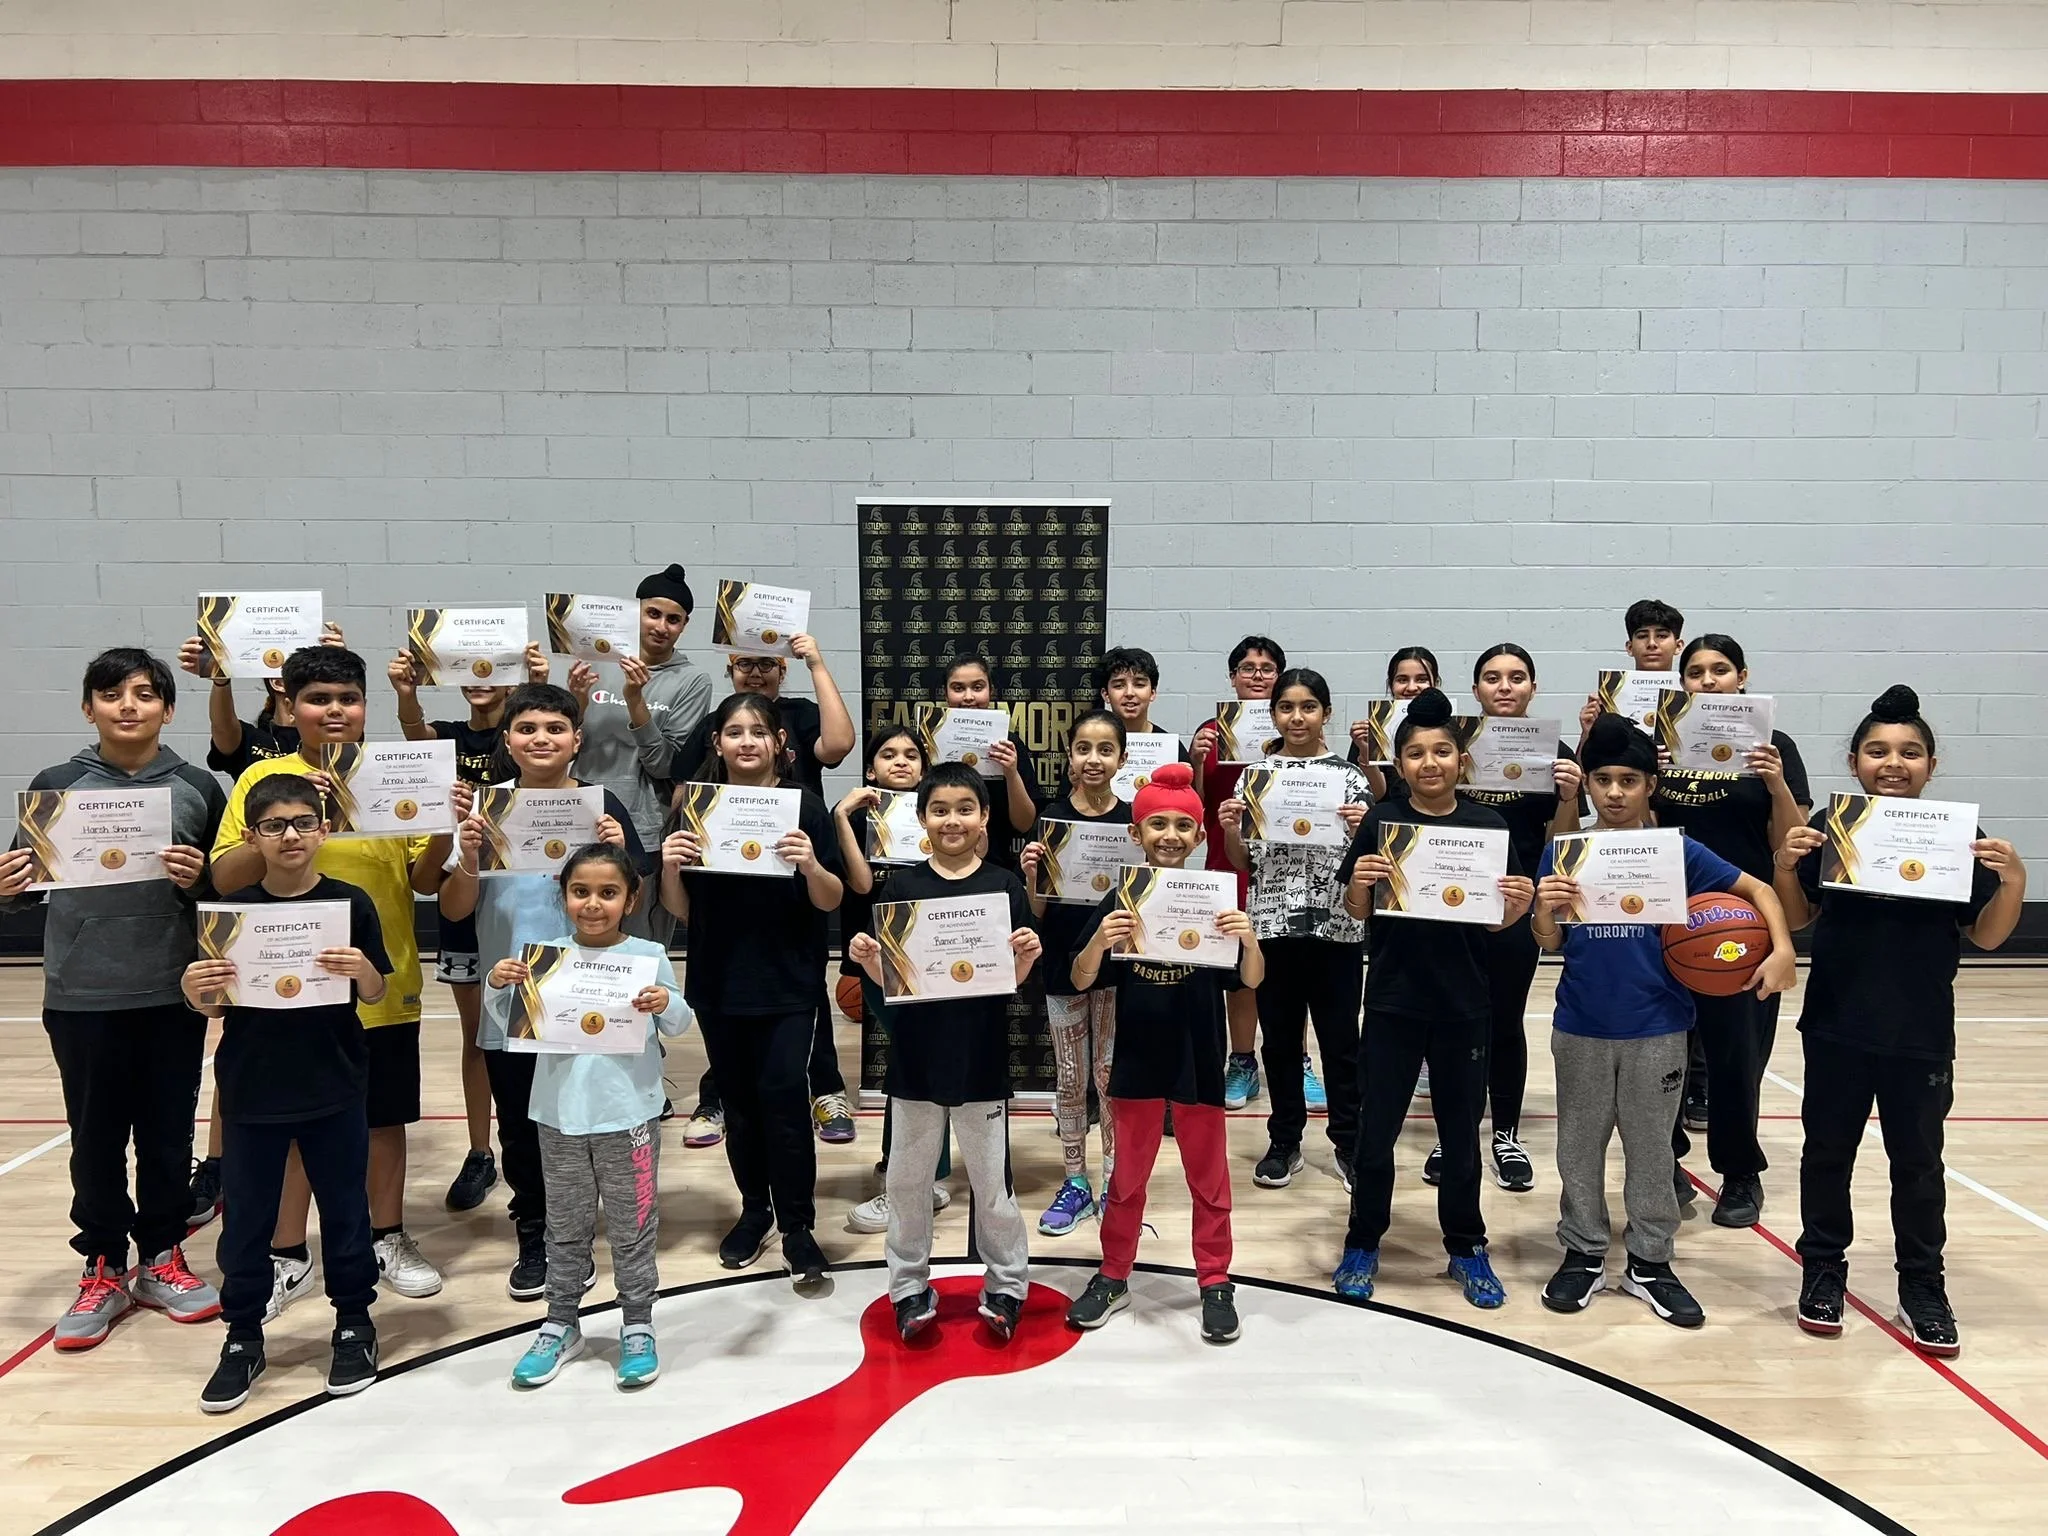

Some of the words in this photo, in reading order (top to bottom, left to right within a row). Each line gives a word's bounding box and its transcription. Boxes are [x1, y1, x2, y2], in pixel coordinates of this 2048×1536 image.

[862, 522, 892, 530] CASTLEMORE
[899, 522, 928, 530] CASTLEMORE
[934, 522, 963, 530] CASTLEMORE
[968, 522, 998, 530] CASTLEMORE
[1002, 522, 1031, 530] CASTLEMORE
[1038, 522, 1067, 530] CASTLEMORE
[1073, 522, 1102, 530] CASTLEMORE
[863, 556, 892, 564] CASTLEMORE
[899, 556, 929, 564] CASTLEMORE
[934, 556, 964, 564] CASTLEMORE
[968, 556, 998, 564] CASTLEMORE
[1001, 556, 1031, 564] CASTLEMORE
[1037, 556, 1067, 564] CASTLEMORE
[1072, 556, 1102, 564] CASTLEMORE
[864, 588, 892, 597] CASTLEMORE
[902, 588, 932, 597] CASTLEMORE
[937, 588, 967, 597] CASTLEMORE
[971, 588, 1000, 597] CASTLEMORE
[1004, 588, 1033, 597] CASTLEMORE
[1040, 588, 1070, 597] CASTLEMORE
[1075, 588, 1103, 597] CASTLEMORE
[753, 593, 793, 604] CERTIFICATE
[864, 621, 892, 629] CASTLEMORE
[902, 621, 932, 629] CASTLEMORE
[938, 621, 967, 629] CASTLEMORE
[971, 621, 1000, 629] CASTLEMORE
[1004, 621, 1033, 629] CASTLEMORE
[1040, 621, 1069, 629] CASTLEMORE
[1074, 621, 1103, 629] CASTLEMORE
[865, 655, 893, 663] CASTLEMORE
[901, 655, 930, 663] CASTLEMORE
[1002, 655, 1031, 663] CASTLEMORE
[1037, 655, 1066, 663] CASTLEMORE
[1072, 655, 1101, 663] CASTLEMORE
[865, 688, 893, 696] CASTLEMORE
[901, 688, 930, 696] CASTLEMORE
[1002, 688, 1031, 696] CASTLEMORE
[1037, 688, 1065, 696] CASTLEMORE
[1072, 688, 1099, 696] CASTLEMORE
[592, 690, 672, 712] Chaion
[1701, 703, 1755, 713] CERTIFICATE
[953, 717, 993, 727] CERTIFICATE
[1492, 726, 1540, 734] CERTIFICATE
[375, 752, 433, 762] CERTIFICATE
[1282, 779, 1328, 789] CERTIFICATE
[1462, 789, 1525, 803] ASKETBALL
[1660, 786, 1729, 804] BASKETBALL
[526, 798, 582, 807] CERTIFICATE
[728, 797, 781, 806] CERTIFICATE
[79, 801, 145, 811] CERTIFICATE
[1884, 809, 1950, 821] CERTIFICATE
[83, 825, 109, 834] Harsh
[112, 824, 142, 834] Sharma
[1080, 834, 1128, 843] CERTIFICATE
[1429, 838, 1485, 849] CERTIFICATE
[1599, 847, 1659, 856] CERTIFICATE
[1167, 881, 1222, 891] CERTIFICATE
[928, 908, 987, 921] CERTIFICATE
[1685, 905, 1758, 932] Wilson
[254, 922, 322, 934] CERTIFICATE
[1586, 925, 1646, 939] TORONTO
[574, 961, 633, 974] CERTIFICATE
[1132, 962, 1196, 982] BASKETBLL
[631, 1143, 656, 1232] SPARKL
